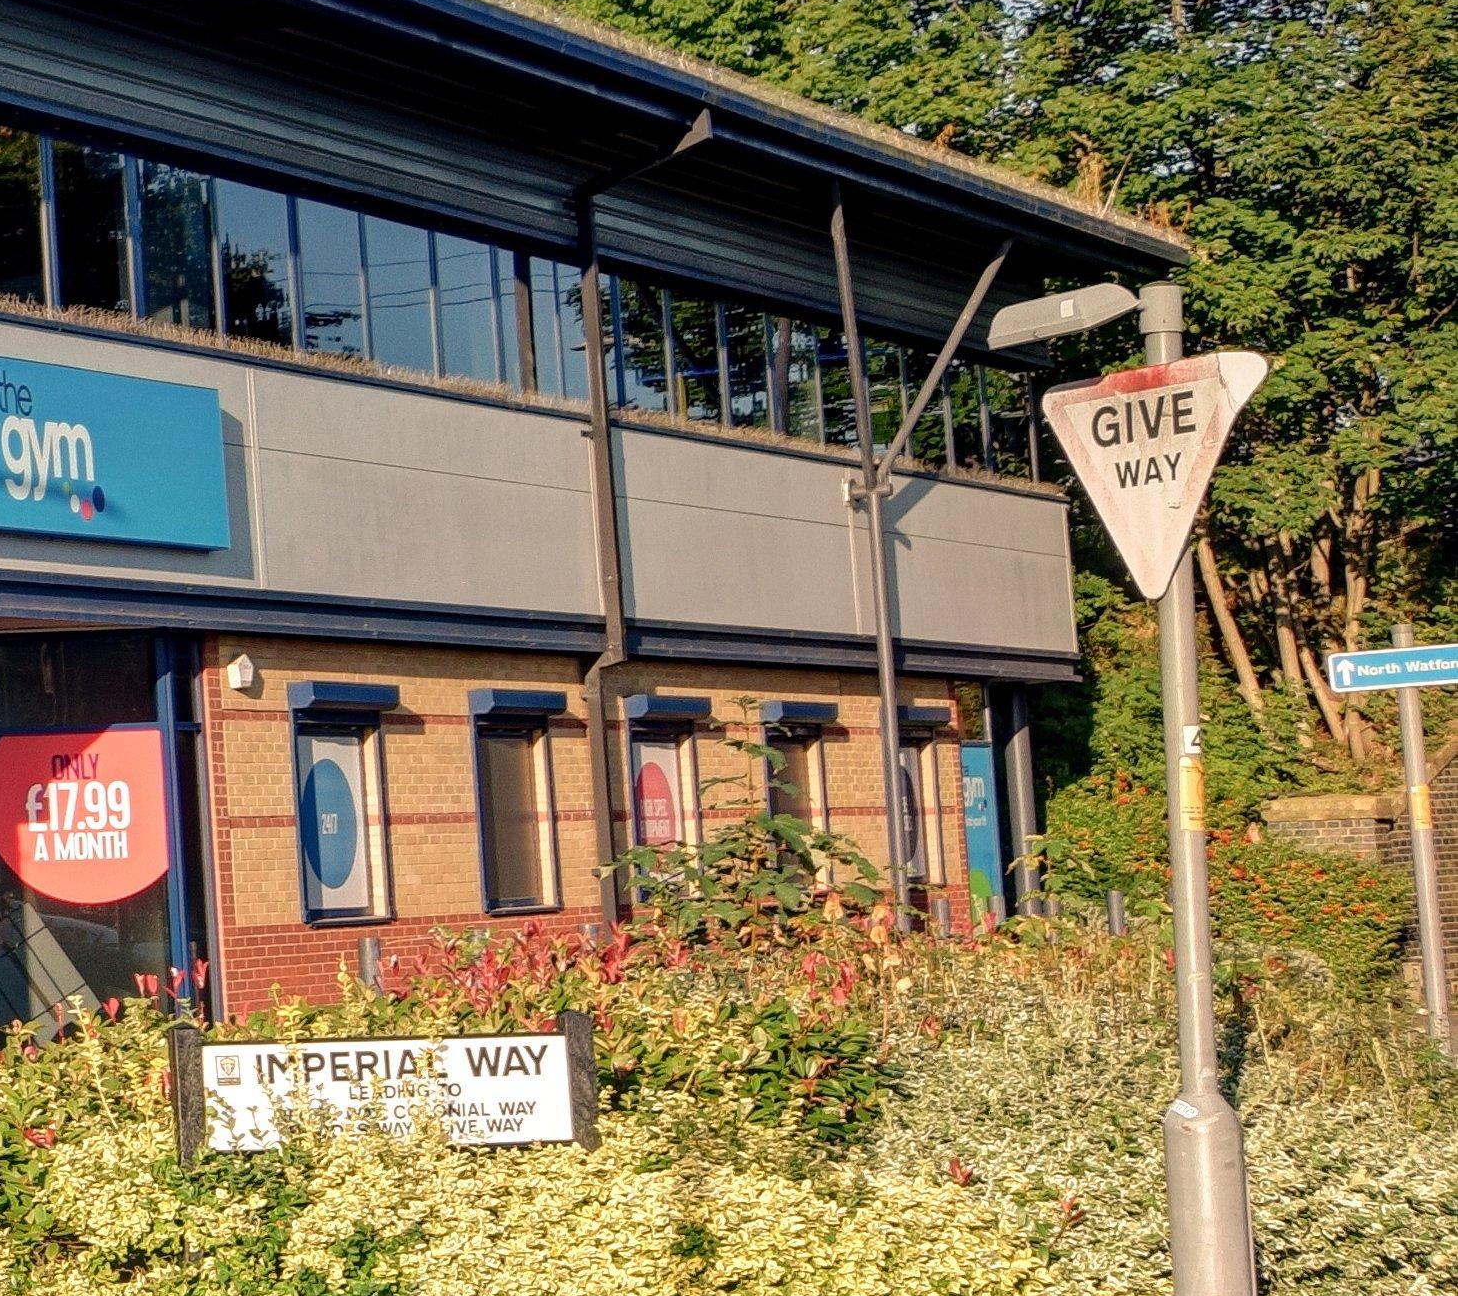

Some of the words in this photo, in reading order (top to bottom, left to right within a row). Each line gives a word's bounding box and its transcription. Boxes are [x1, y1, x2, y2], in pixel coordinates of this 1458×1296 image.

[1091, 390, 1197, 448] GIVE
[1, 415, 95, 501] gym
[1114, 452, 1182, 489] WAY
[1357, 662, 1401, 677] North
[1404, 658, 1458, 673] Watfor
[51, 753, 100, 780] ONLY
[25, 780, 132, 832] £17.99
[33, 832, 50, 862] A
[53, 831, 129, 861] MONTH
[464, 1044, 549, 1077] WAY
[348, 1083, 431, 1101] LEDING
[393, 1103, 491, 1120] COONIAL
[498, 1101, 537, 1116] WAY
[485, 1117, 525, 1133] WAY
